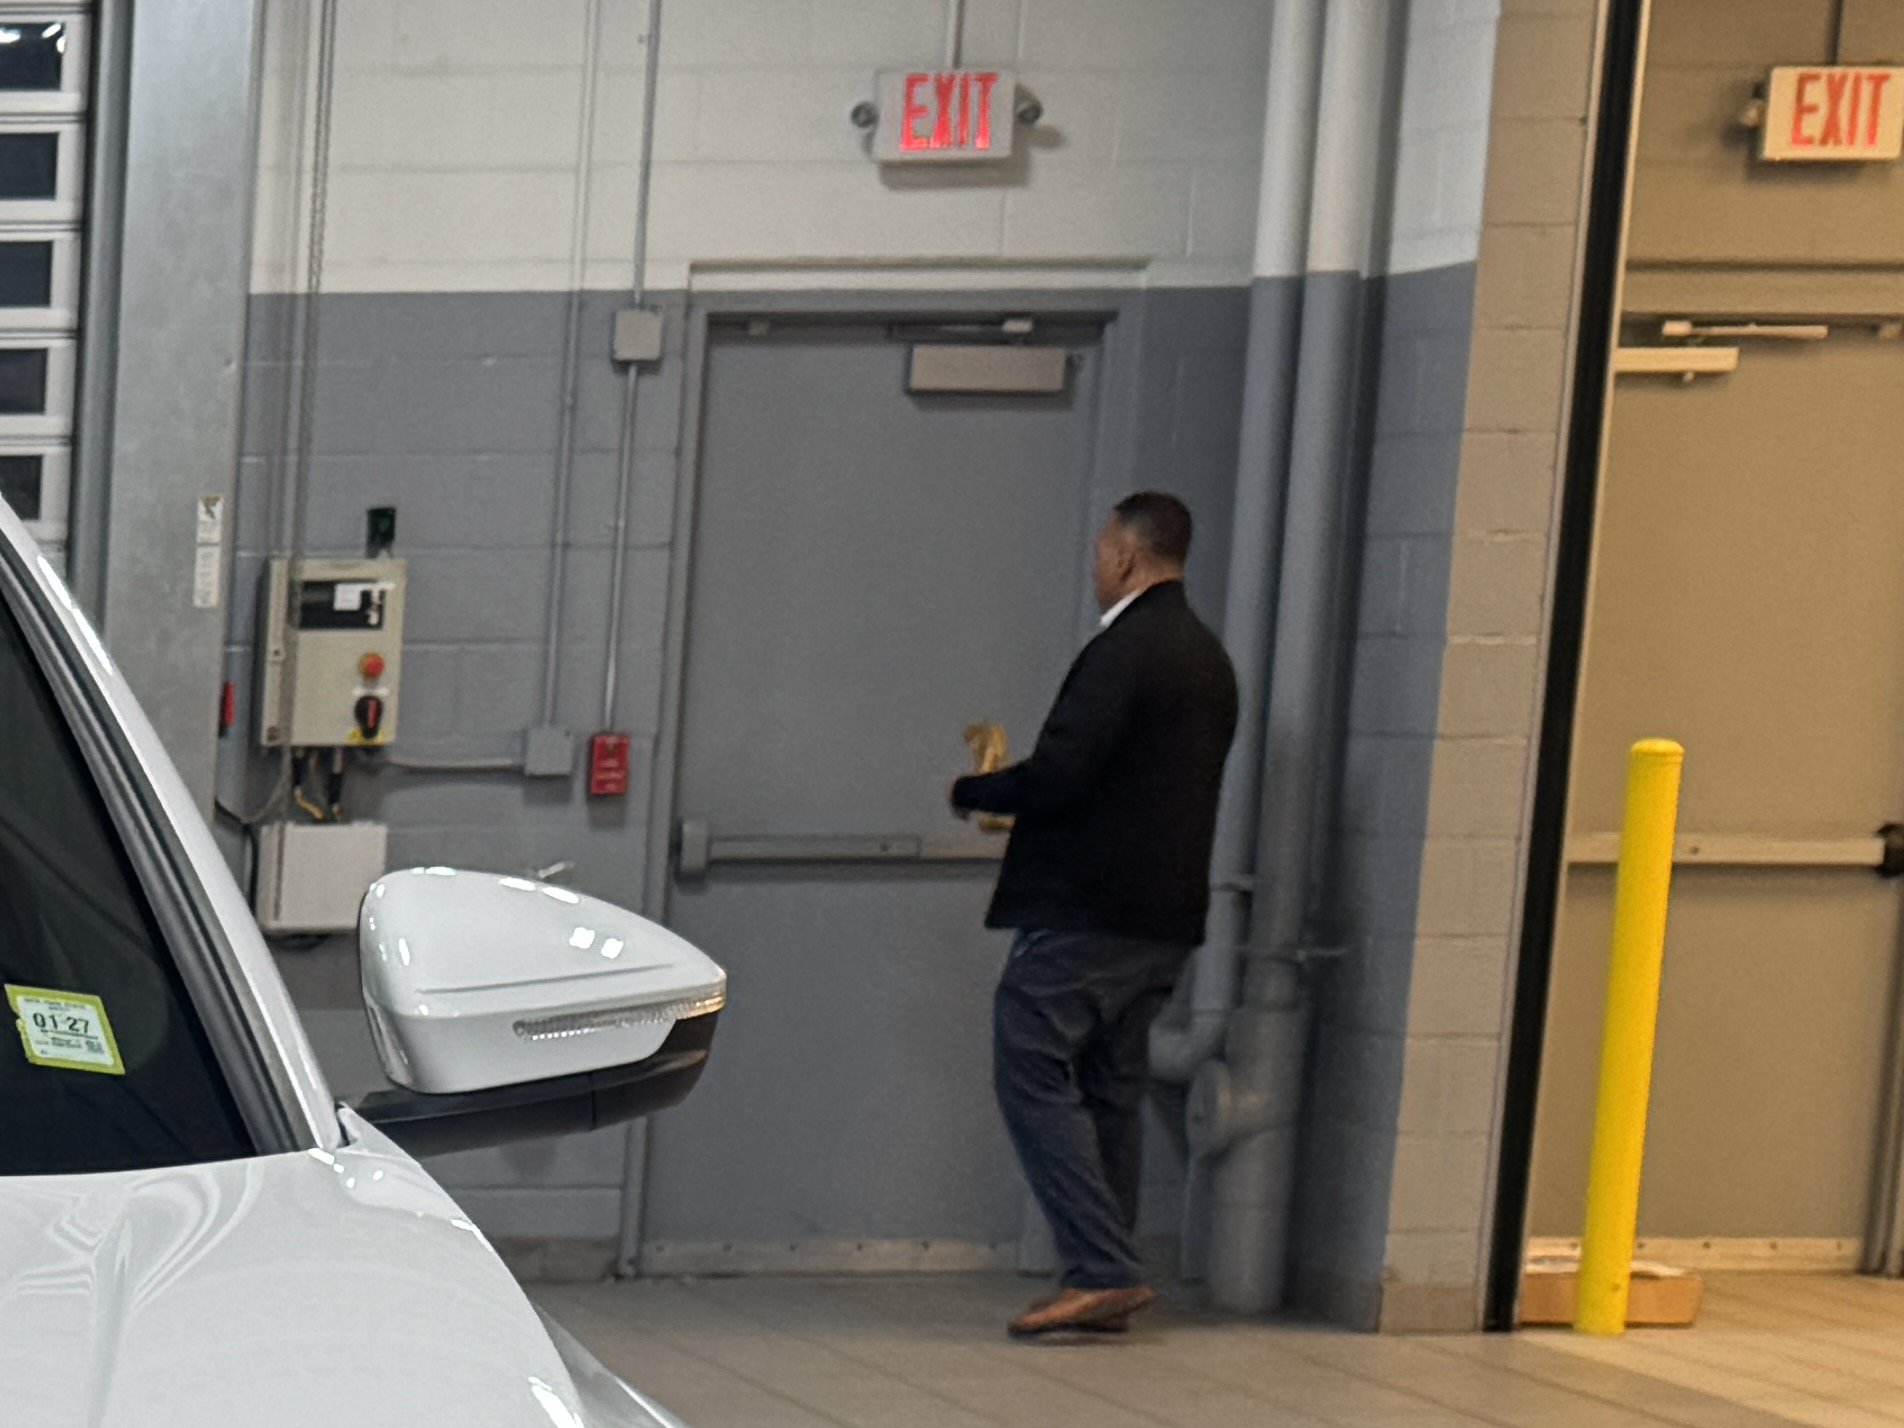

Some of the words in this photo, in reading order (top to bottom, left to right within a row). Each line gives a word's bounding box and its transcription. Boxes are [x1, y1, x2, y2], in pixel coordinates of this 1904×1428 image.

[899, 72, 1000, 152] EXIT
[1790, 72, 1891, 146] EXIT
[32, 1012, 58, 1030] 01
[66, 1015, 90, 1034] 27
